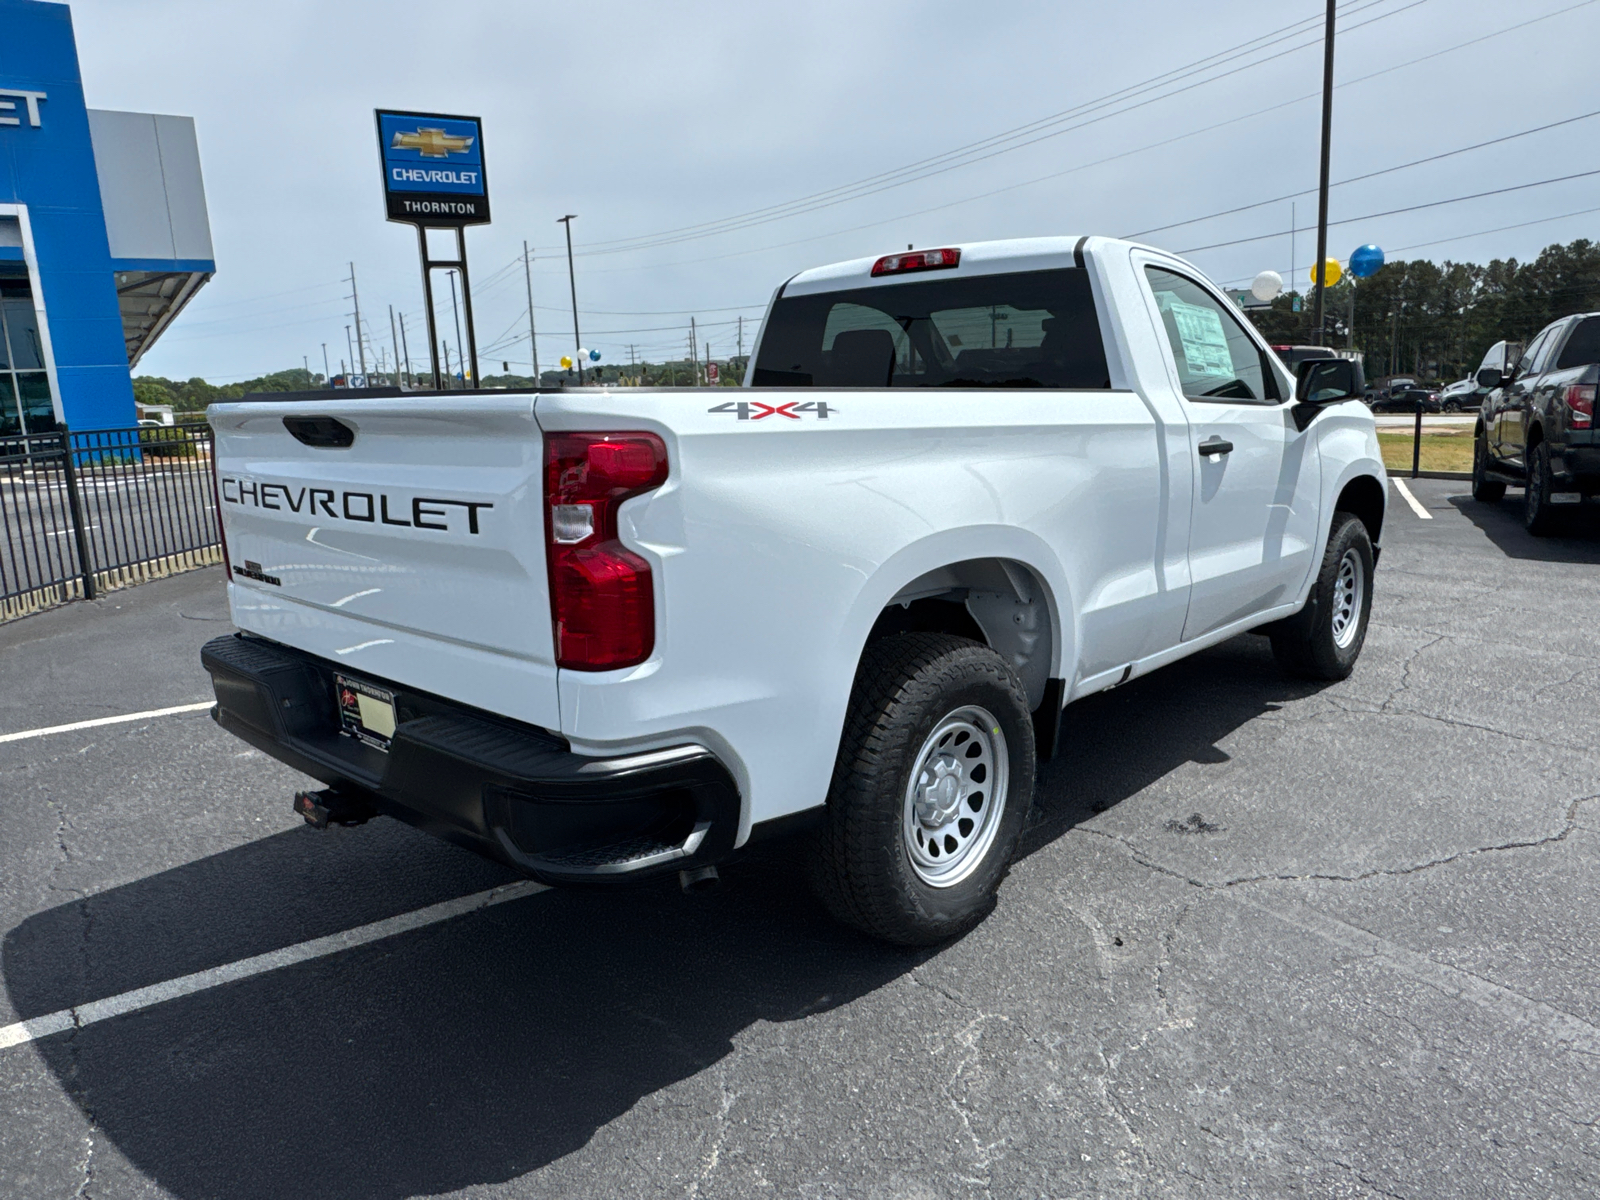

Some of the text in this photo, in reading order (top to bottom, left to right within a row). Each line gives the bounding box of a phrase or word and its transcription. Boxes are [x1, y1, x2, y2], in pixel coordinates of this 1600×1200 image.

[392, 168, 478, 184] CHEVROLET
[403, 201, 475, 214] THORNTON
[222, 478, 494, 534] CHEVROLET
